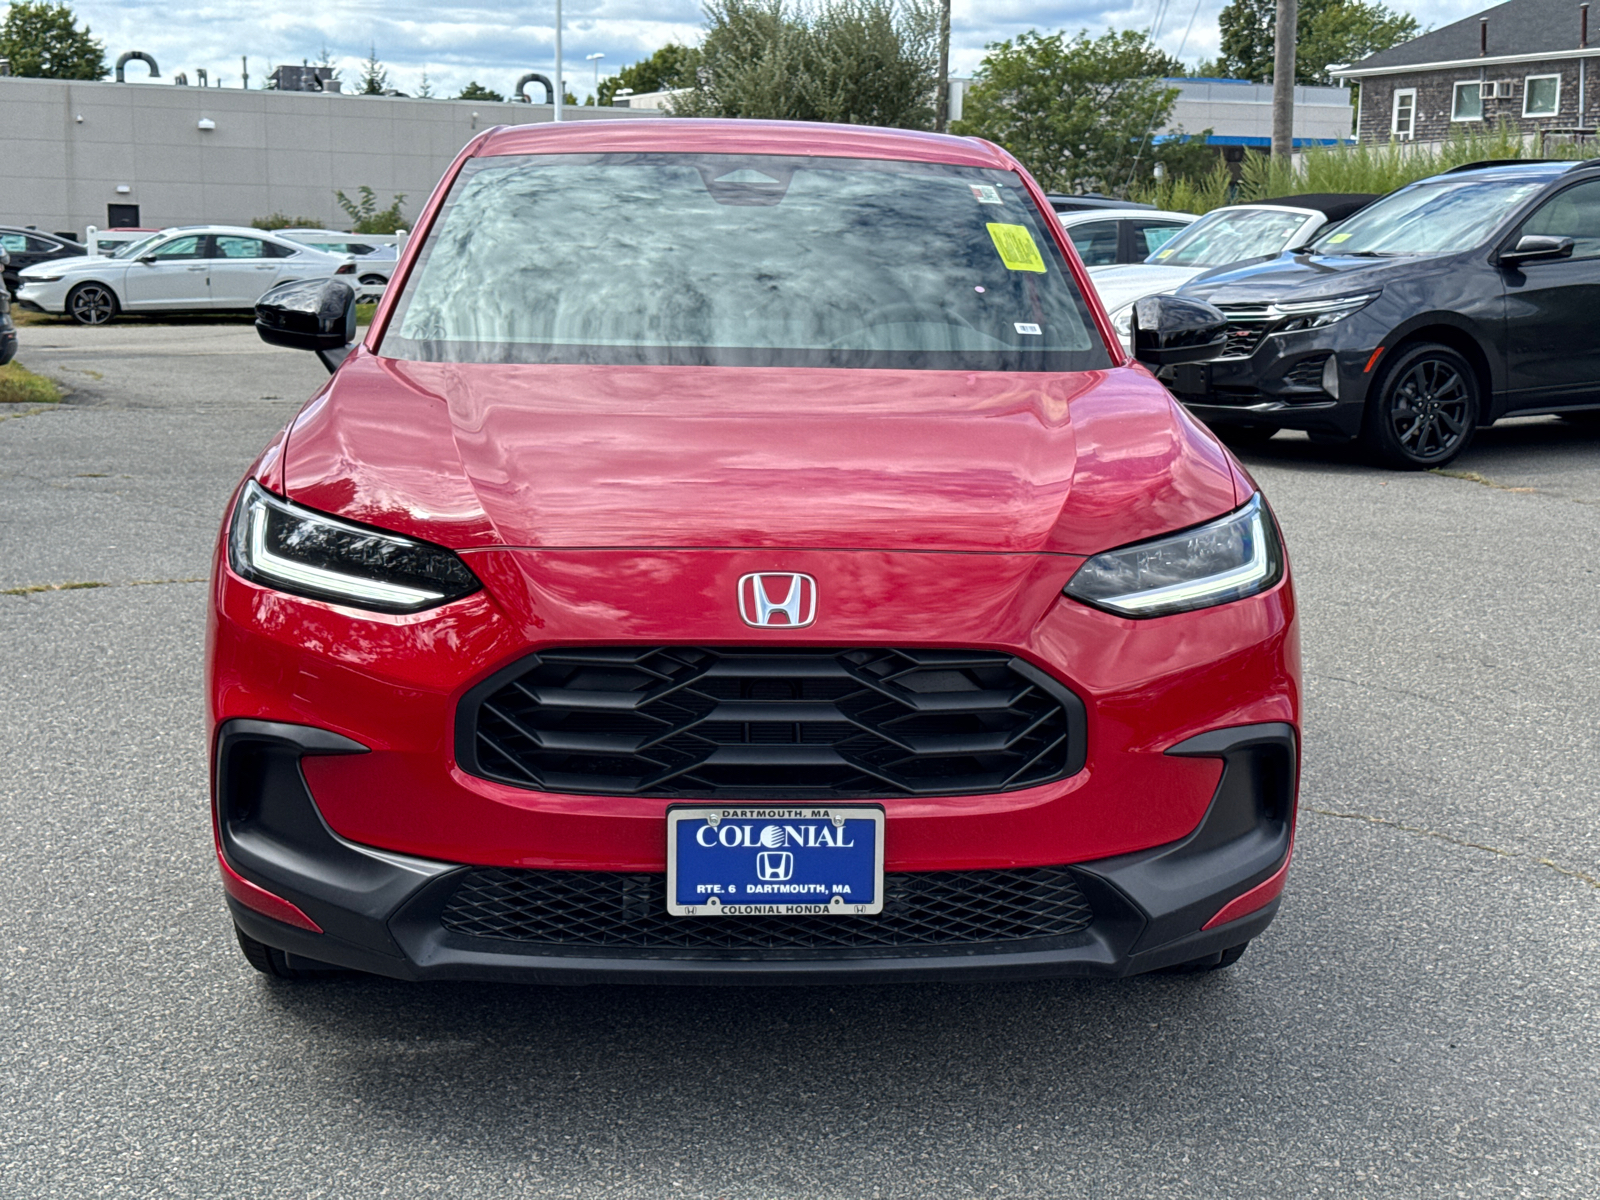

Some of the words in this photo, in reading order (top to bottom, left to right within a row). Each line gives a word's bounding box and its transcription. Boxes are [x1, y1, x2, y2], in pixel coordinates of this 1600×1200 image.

[722, 810, 807, 818] DARTMOUTH,
[811, 810, 830, 818] MA
[696, 825, 854, 848] COLONIAL
[696, 884, 725, 894] RTE.
[728, 884, 736, 893] 6
[746, 884, 829, 895] DARTMOUTH,
[832, 884, 851, 894] MA
[721, 905, 782, 914] COLONIAL
[786, 905, 830, 914] HONDA
